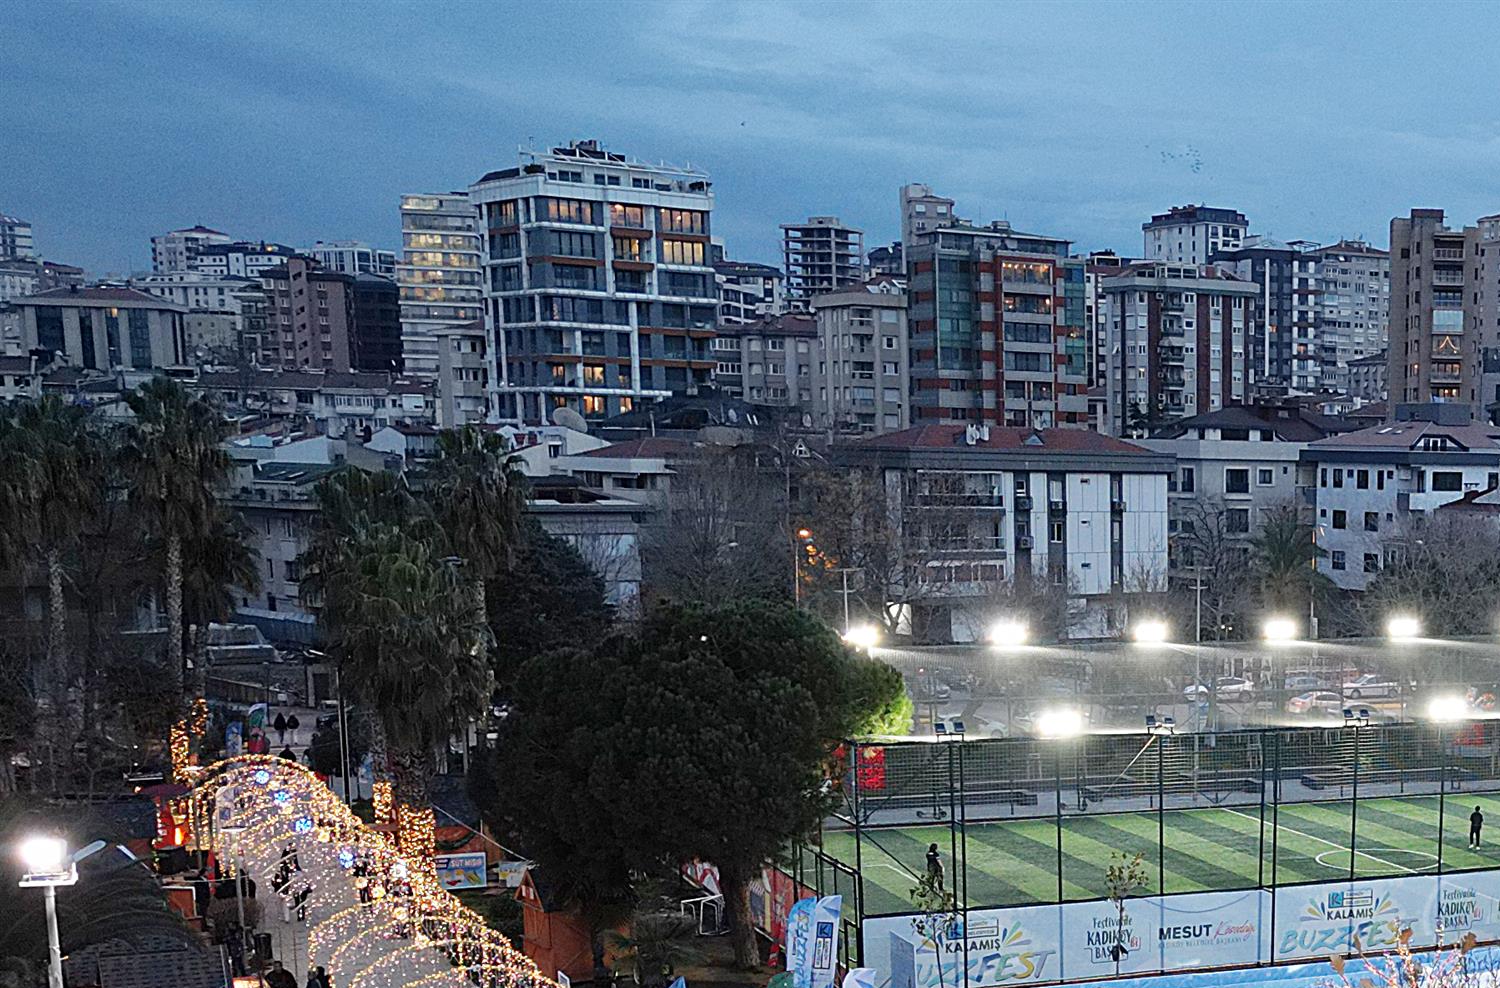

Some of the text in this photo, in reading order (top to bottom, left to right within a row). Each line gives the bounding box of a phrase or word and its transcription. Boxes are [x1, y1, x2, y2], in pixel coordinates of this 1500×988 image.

[1326, 908, 1374, 921] KALAMIŞ
[1158, 923, 1213, 941] MESUT
[945, 938, 1001, 954] KAAMIŞ
[916, 950, 1056, 988] UZZFEST
